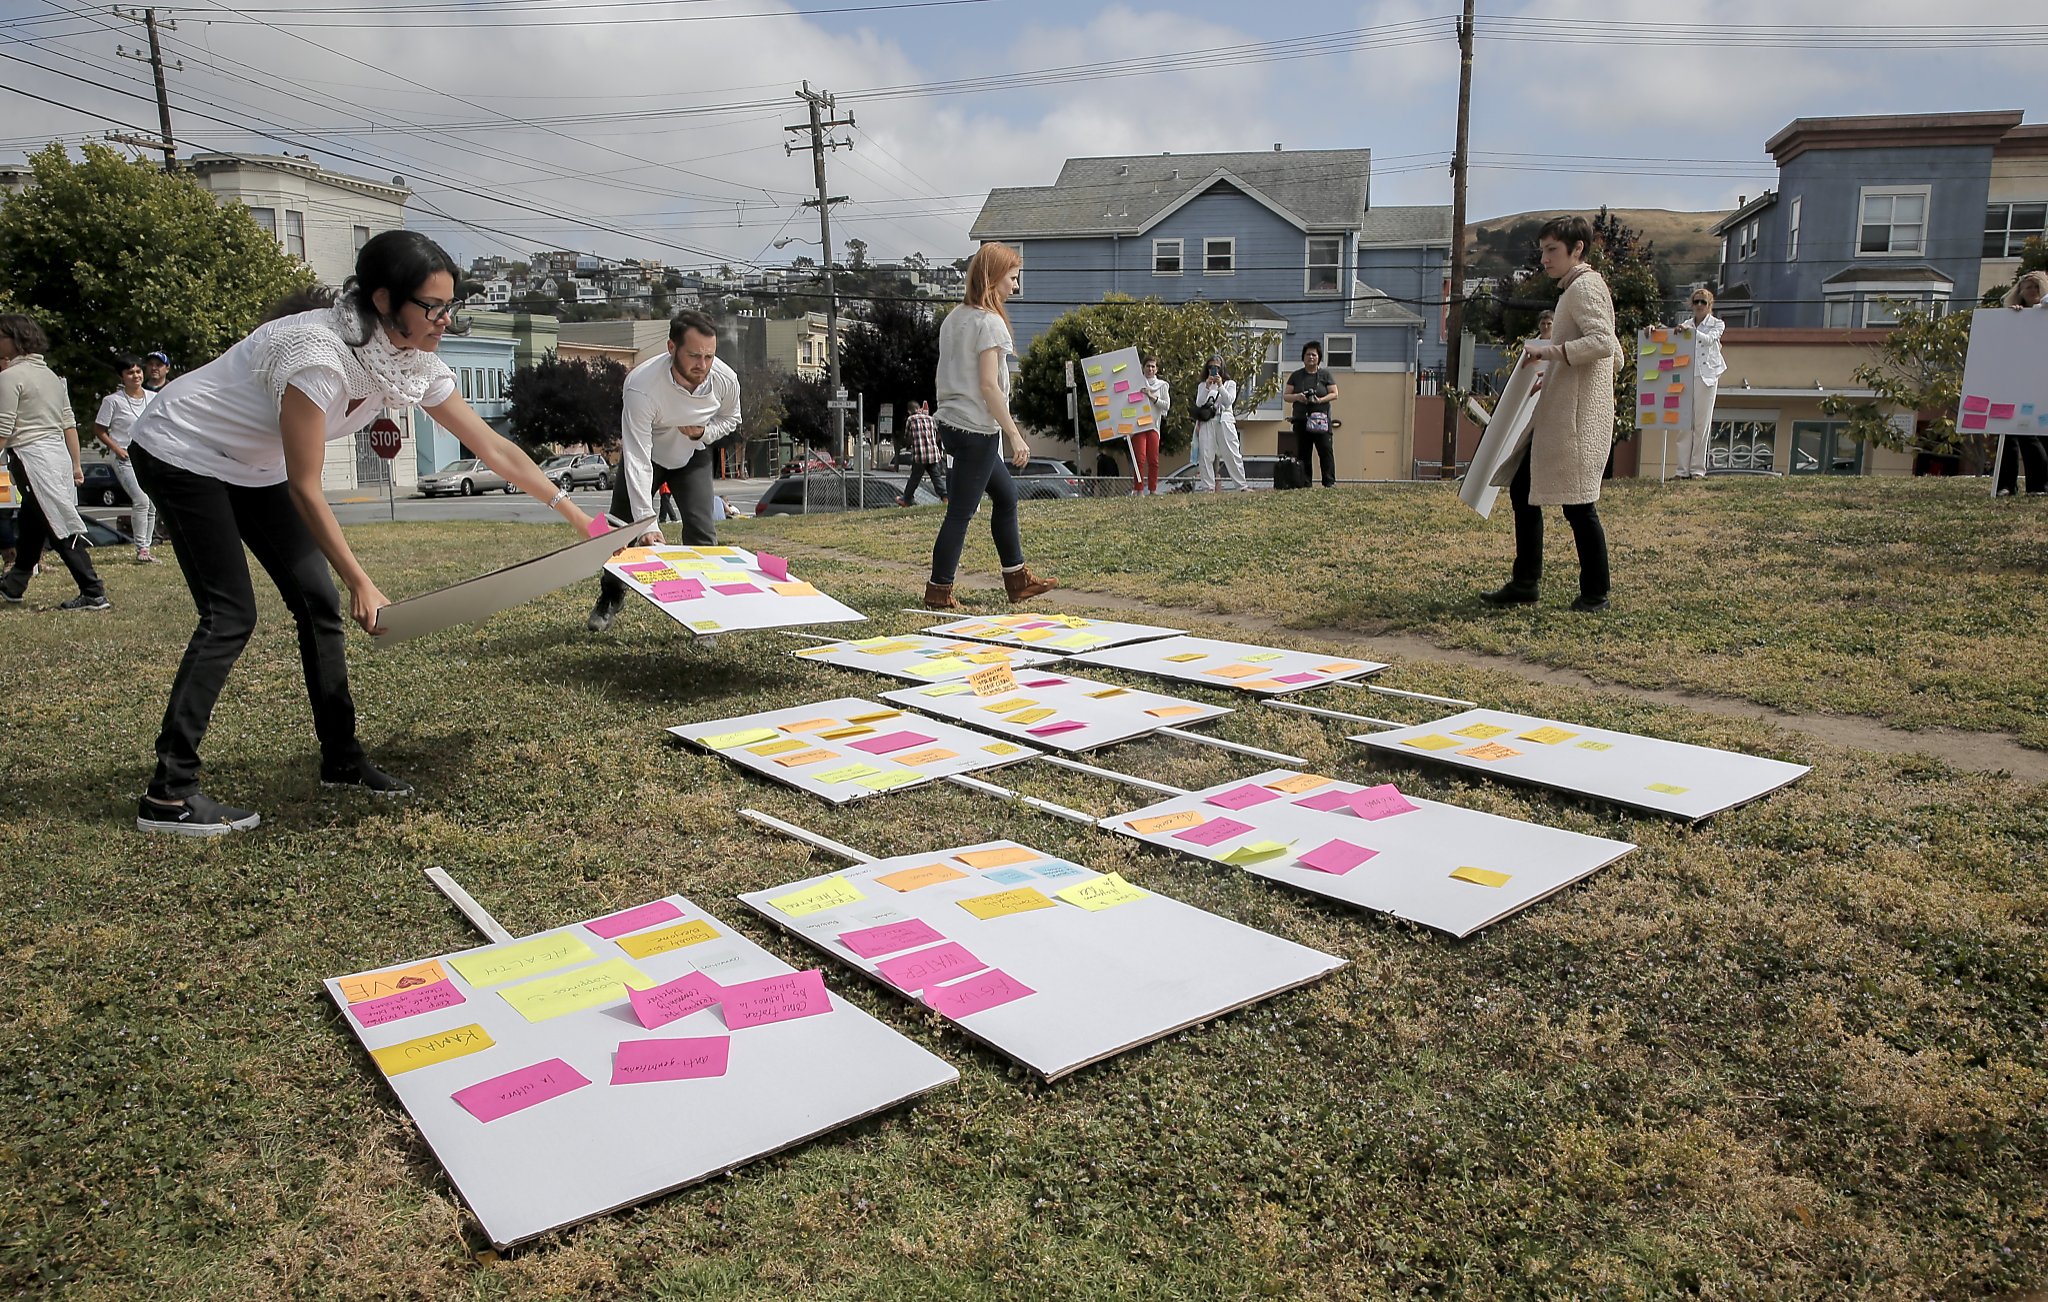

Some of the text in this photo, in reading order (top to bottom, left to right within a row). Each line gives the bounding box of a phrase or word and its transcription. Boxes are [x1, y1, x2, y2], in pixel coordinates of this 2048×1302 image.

[371, 431, 399, 446] STOP
[808, 894, 857, 911] FREE
[484, 947, 568, 976] HEALTH
[895, 952, 964, 980] WATER
[753, 992, 786, 1006] latinos
[742, 1005, 780, 1020] tratan
[404, 1029, 479, 1059] KAMAU
